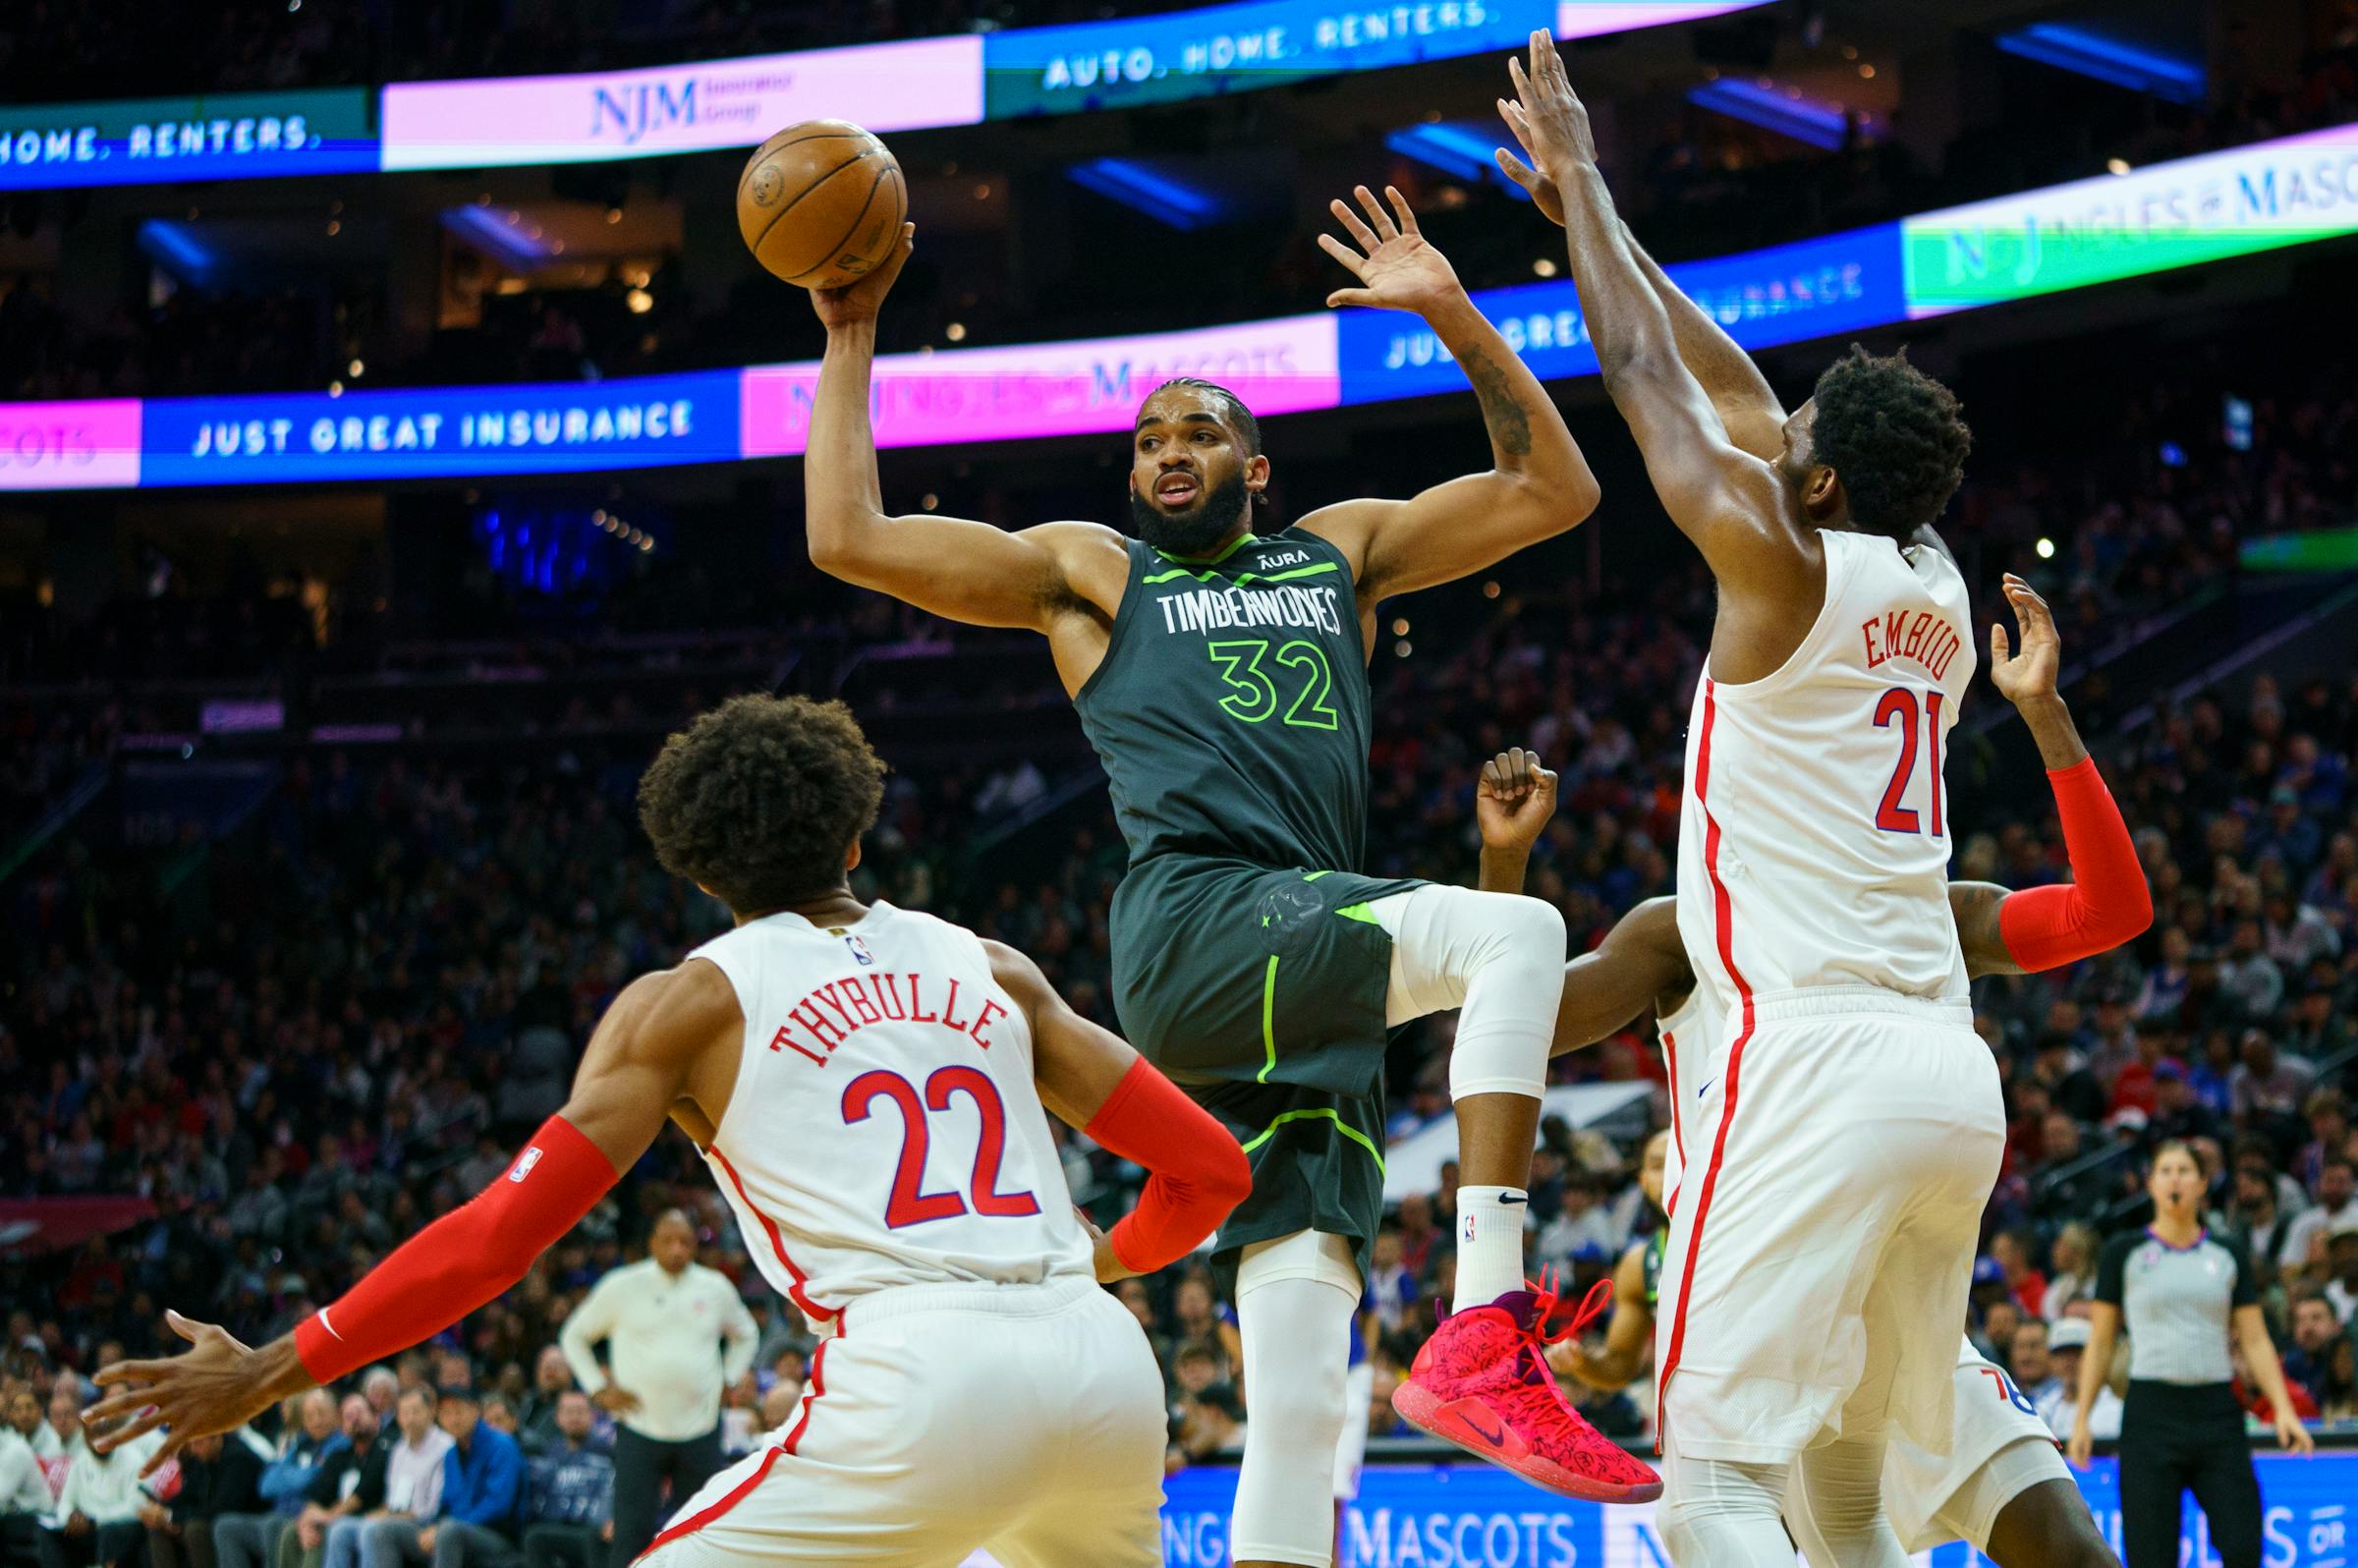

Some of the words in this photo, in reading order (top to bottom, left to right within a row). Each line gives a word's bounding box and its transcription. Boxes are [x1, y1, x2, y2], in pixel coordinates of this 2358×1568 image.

[590, 78, 698, 144] NJM
[1382, 329, 1455, 369] JUS
[1498, 309, 1592, 355] GRE
[192, 417, 292, 458] JUST
[309, 413, 441, 453] GREAT
[461, 398, 694, 449] INSURANCE
[1156, 586, 1341, 637] TIMBERWOLVES
[1862, 609, 1960, 682] EMBIID
[1207, 640, 1338, 731] 32
[1873, 687, 1943, 837] 21
[768, 973, 1008, 1069] THYBULLE
[841, 1064, 1042, 1230] 22
[1347, 1507, 1578, 1568] MASCOTS
